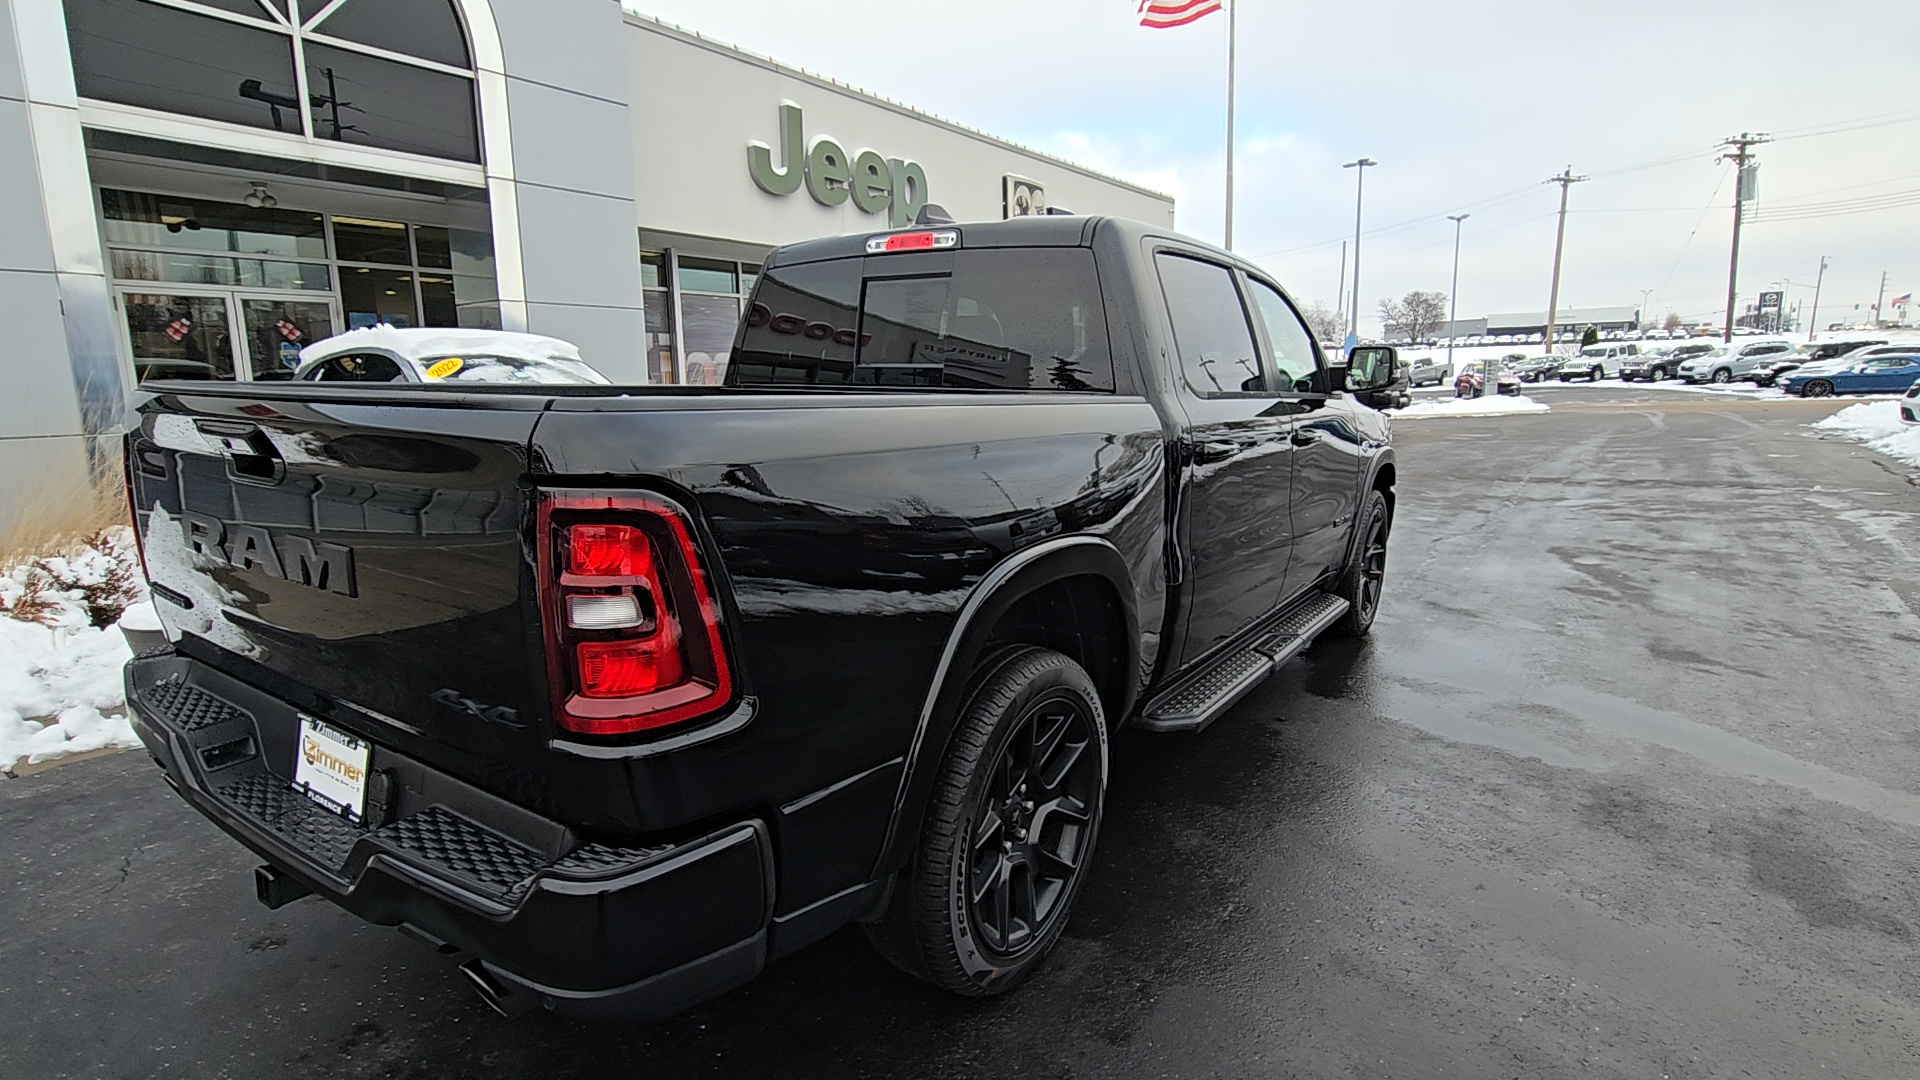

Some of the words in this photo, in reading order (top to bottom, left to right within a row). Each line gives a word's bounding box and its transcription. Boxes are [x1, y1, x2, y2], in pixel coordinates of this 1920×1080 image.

[747, 100, 928, 229] Jeep
[431, 360, 459, 378] 2022
[181, 509, 358, 598] RAM
[315, 720, 351, 746] Zimmer
[304, 737, 364, 783] Zimmer
[307, 790, 342, 815] FLORENCE
[956, 816, 972, 939] SCORPION
